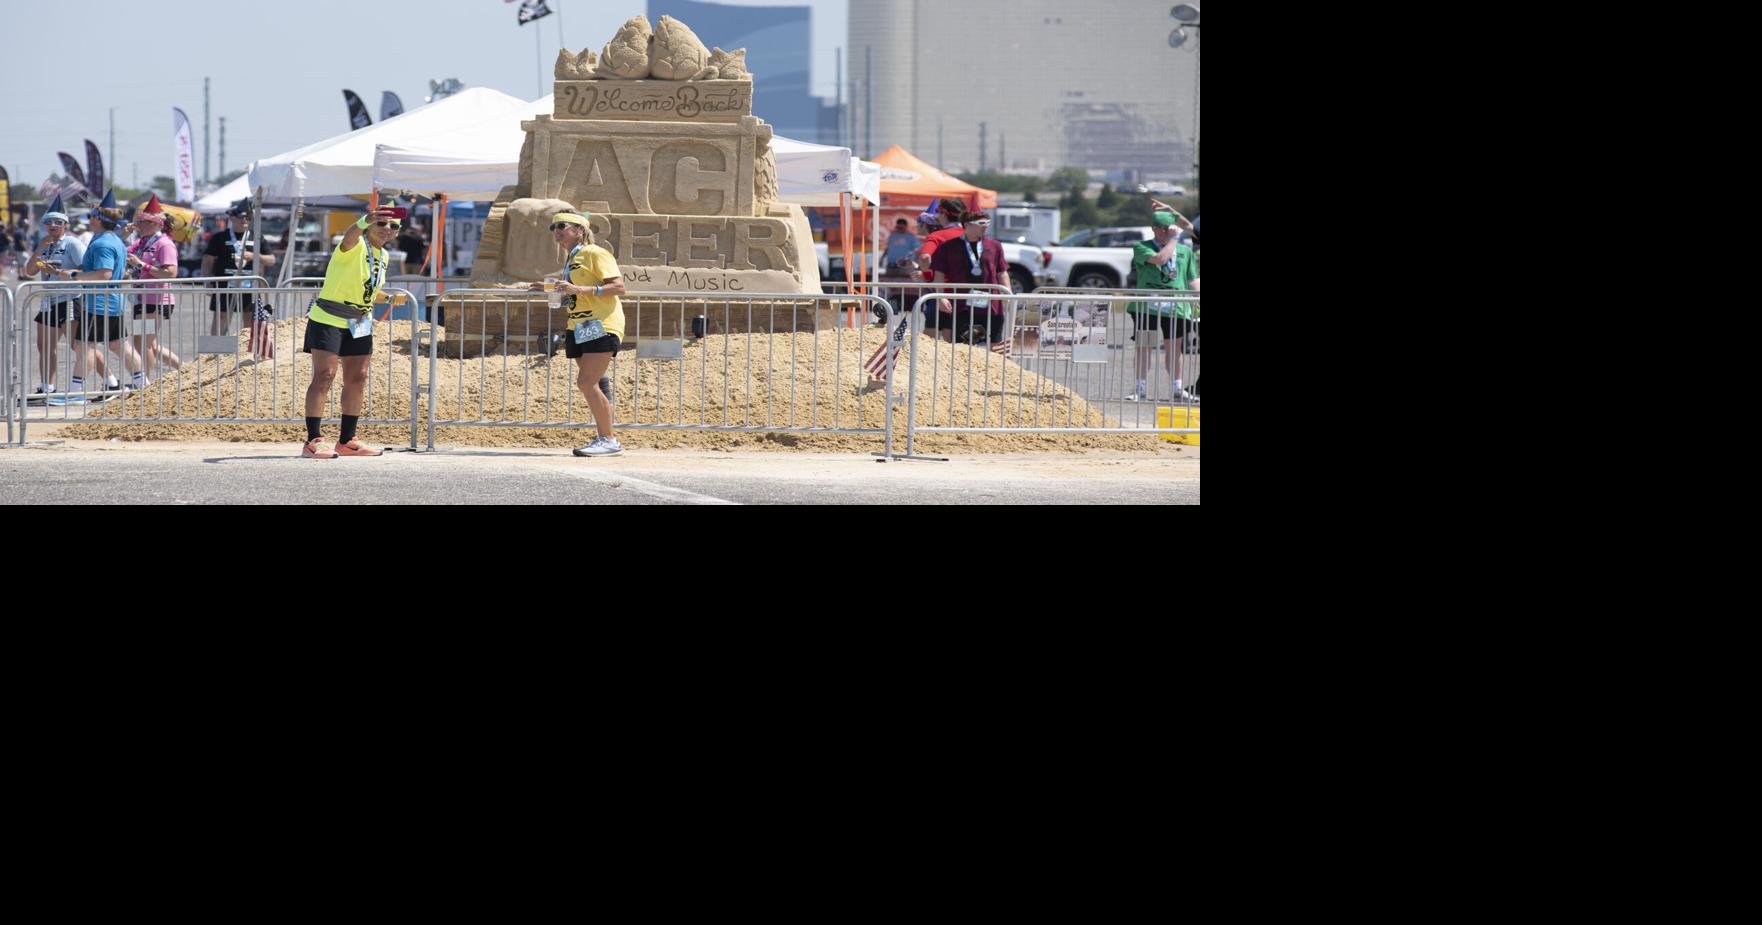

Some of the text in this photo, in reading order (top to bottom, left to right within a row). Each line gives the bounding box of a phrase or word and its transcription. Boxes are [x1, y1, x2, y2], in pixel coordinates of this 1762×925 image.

[564, 85, 743, 118] Welcome Back
[558, 139, 726, 215] AC
[667, 270, 745, 292] Music
[578, 325, 600, 339] 263
